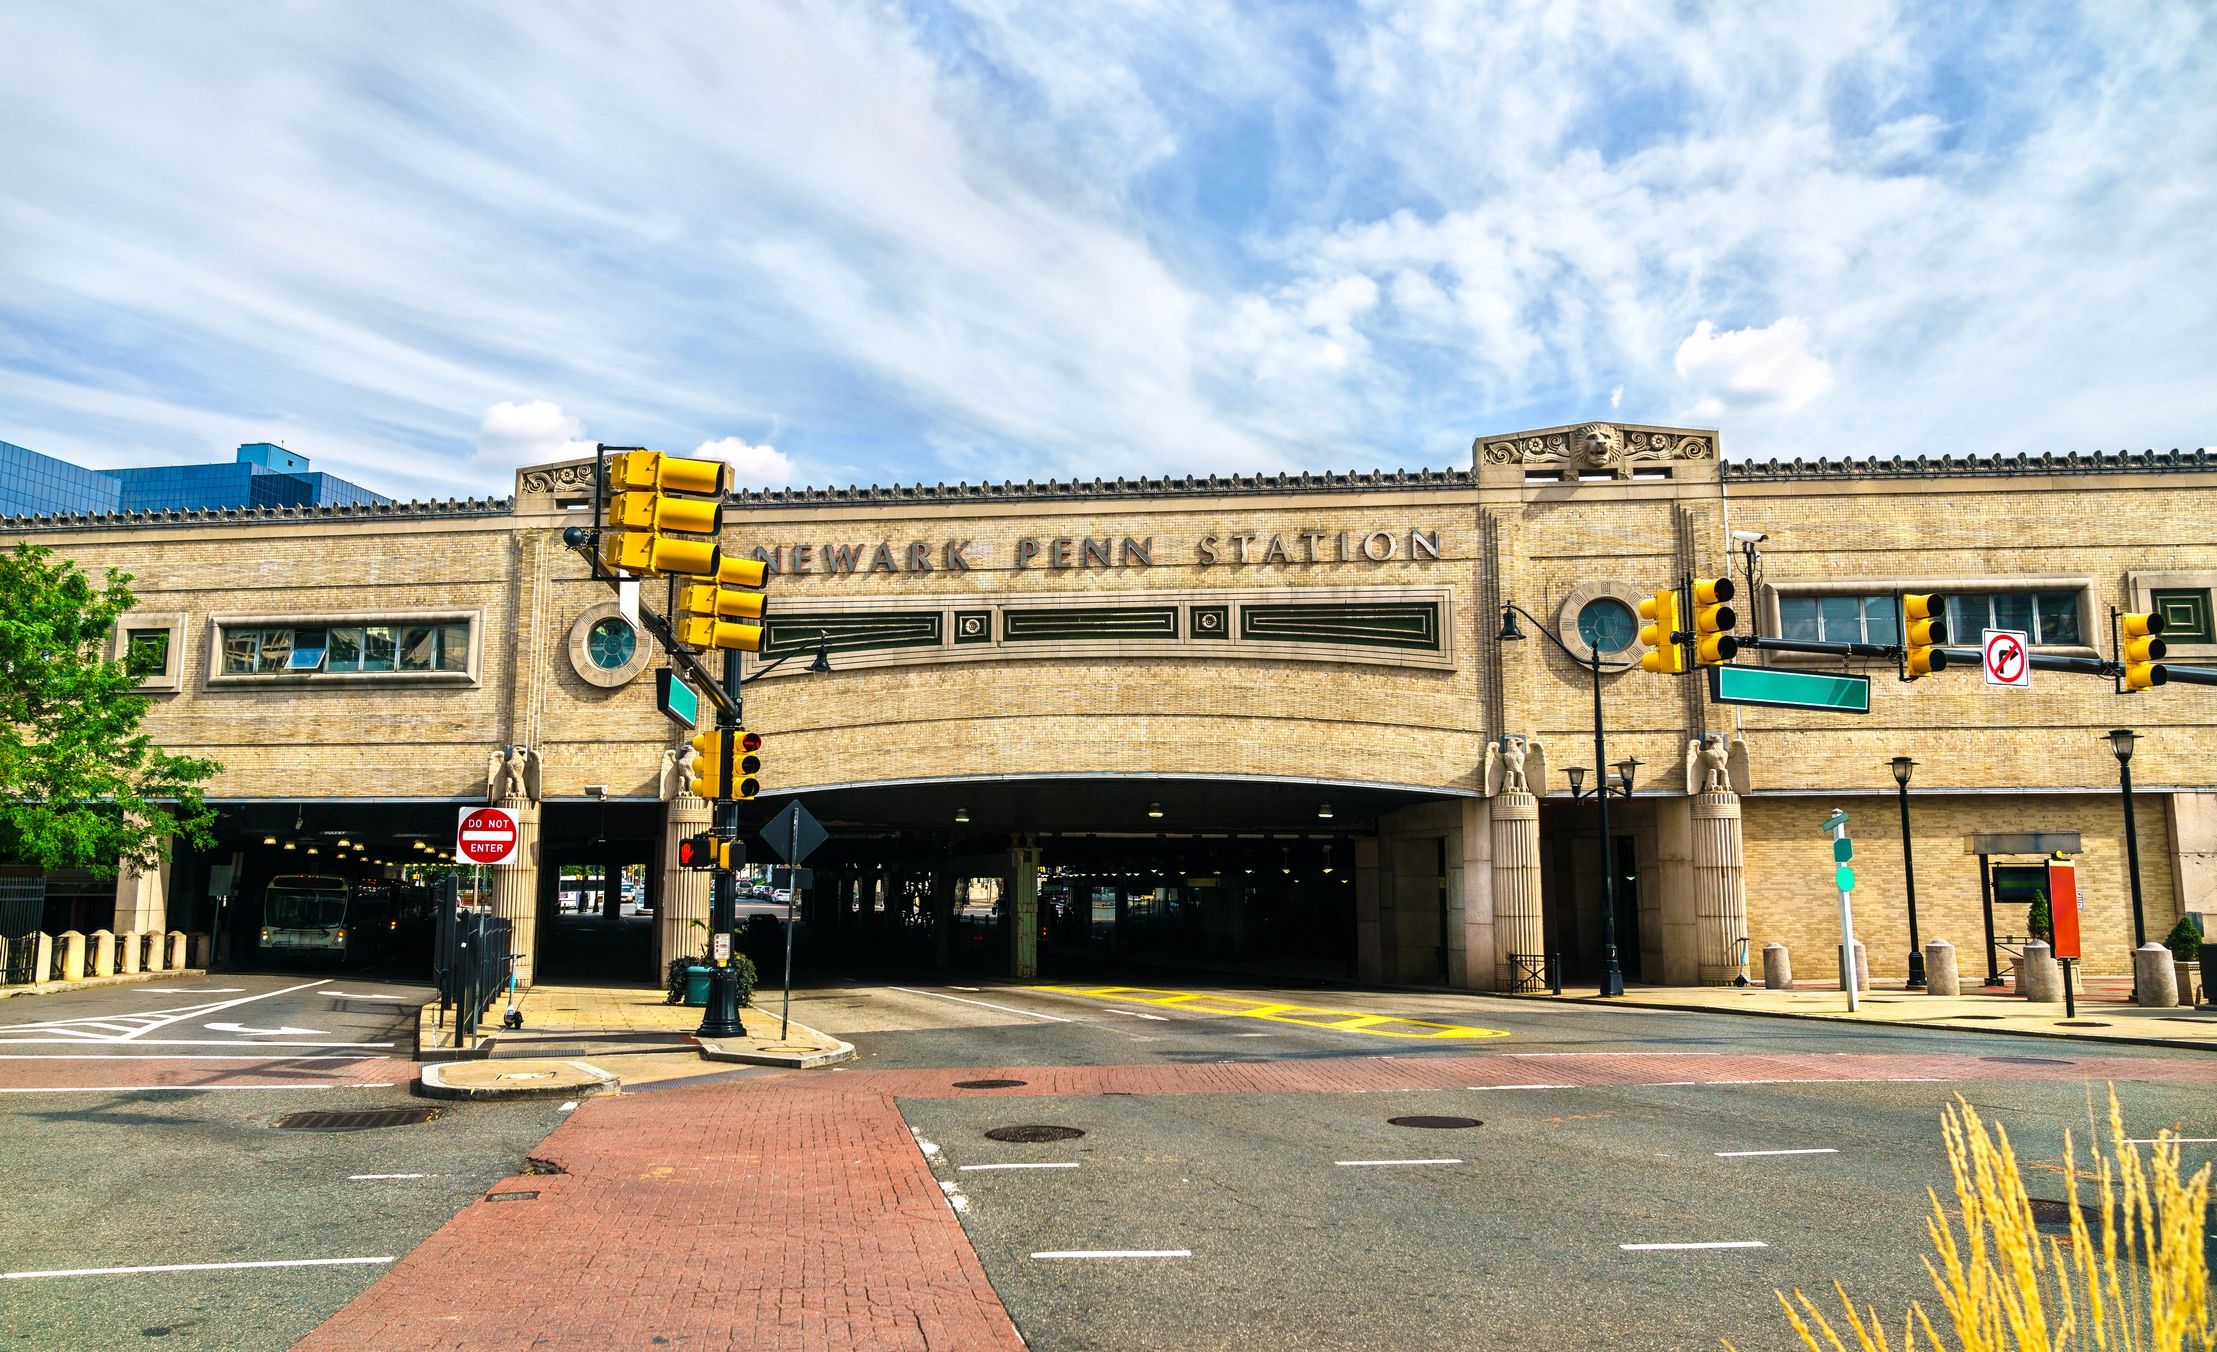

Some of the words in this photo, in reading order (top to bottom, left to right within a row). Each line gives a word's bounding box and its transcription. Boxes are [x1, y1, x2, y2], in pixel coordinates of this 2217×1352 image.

[755, 539, 971, 575] NEWARK
[1019, 536, 1152, 569] PENN
[1200, 528, 1441, 566] STATION
[468, 819, 483, 828] DO
[488, 819, 509, 828] NOT
[470, 843, 503, 853] ENTER
